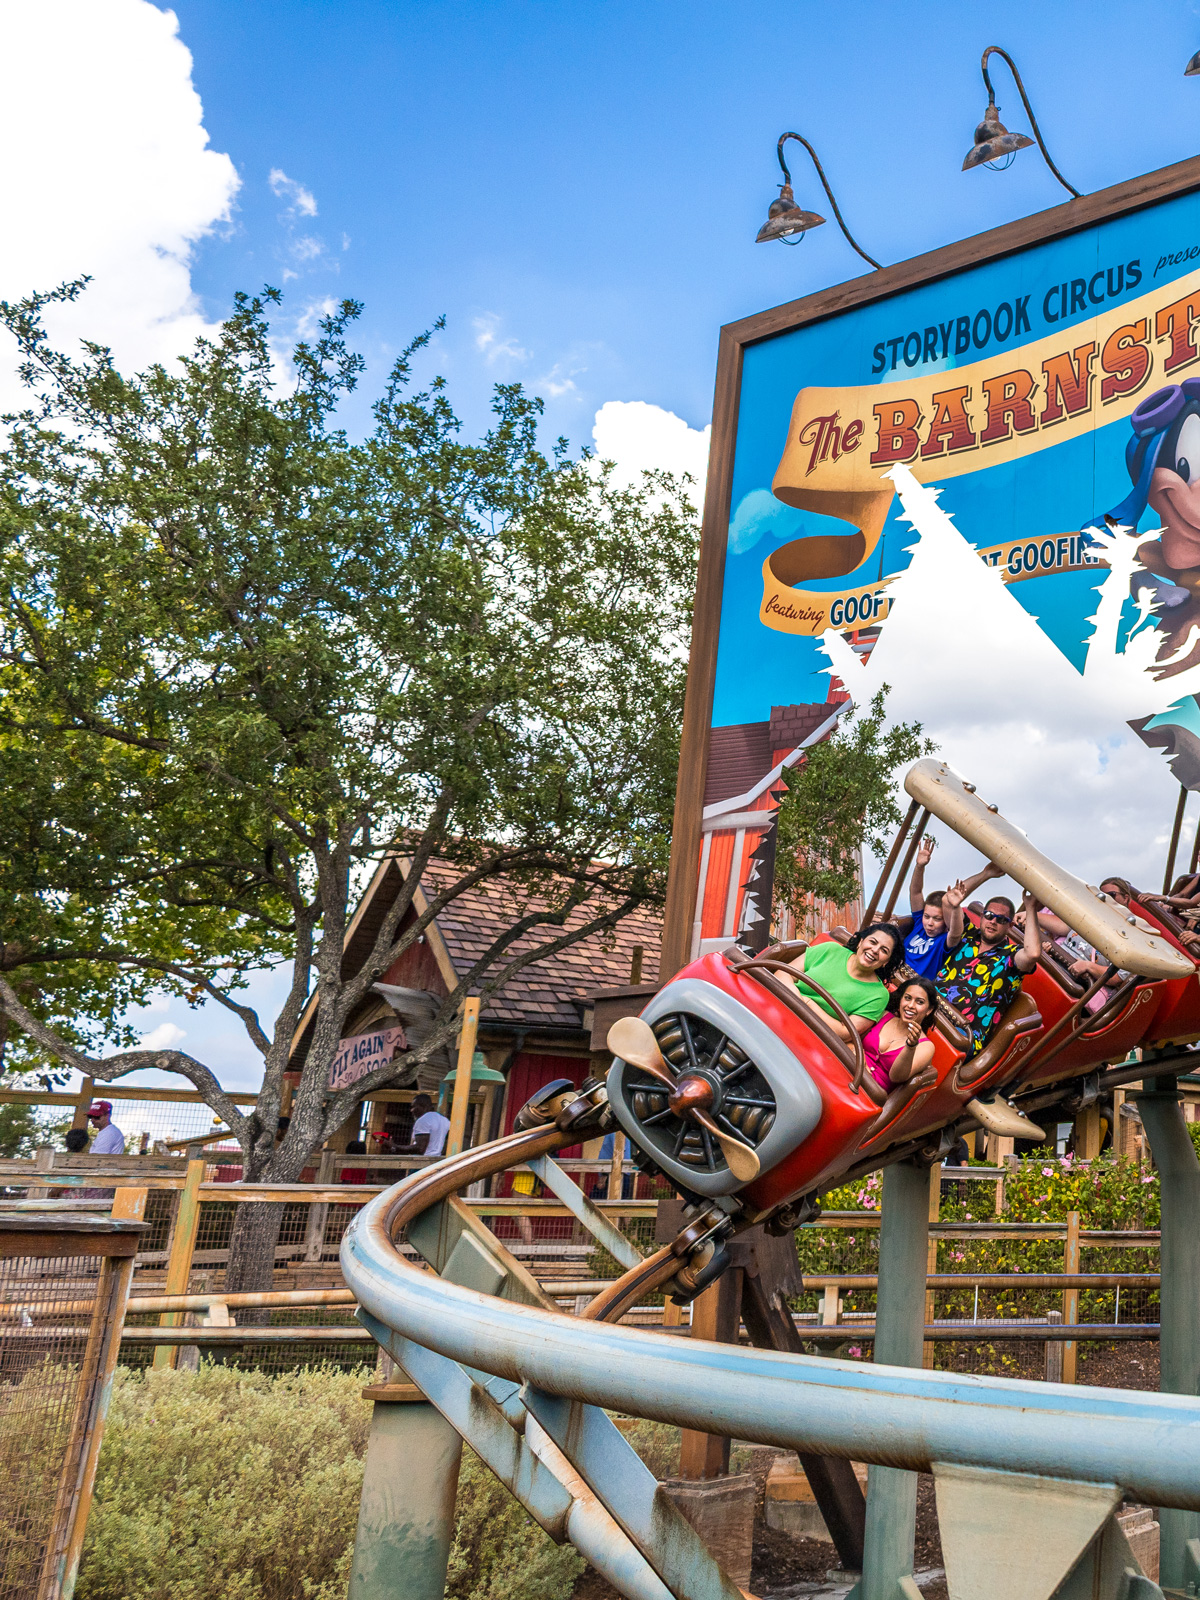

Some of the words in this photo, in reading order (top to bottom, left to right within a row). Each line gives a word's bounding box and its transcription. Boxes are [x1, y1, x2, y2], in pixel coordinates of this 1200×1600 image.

[871, 294, 1033, 374] STORYBOOK
[1042, 259, 1144, 324] CIRCUS
[799, 410, 865, 477] The
[765, 594, 826, 632] featuring
[830, 590, 896, 626] GOOF
[332, 1049, 350, 1085] FLY
[351, 1035, 385, 1065] AGAIN
[367, 1056, 392, 1073] SOO
